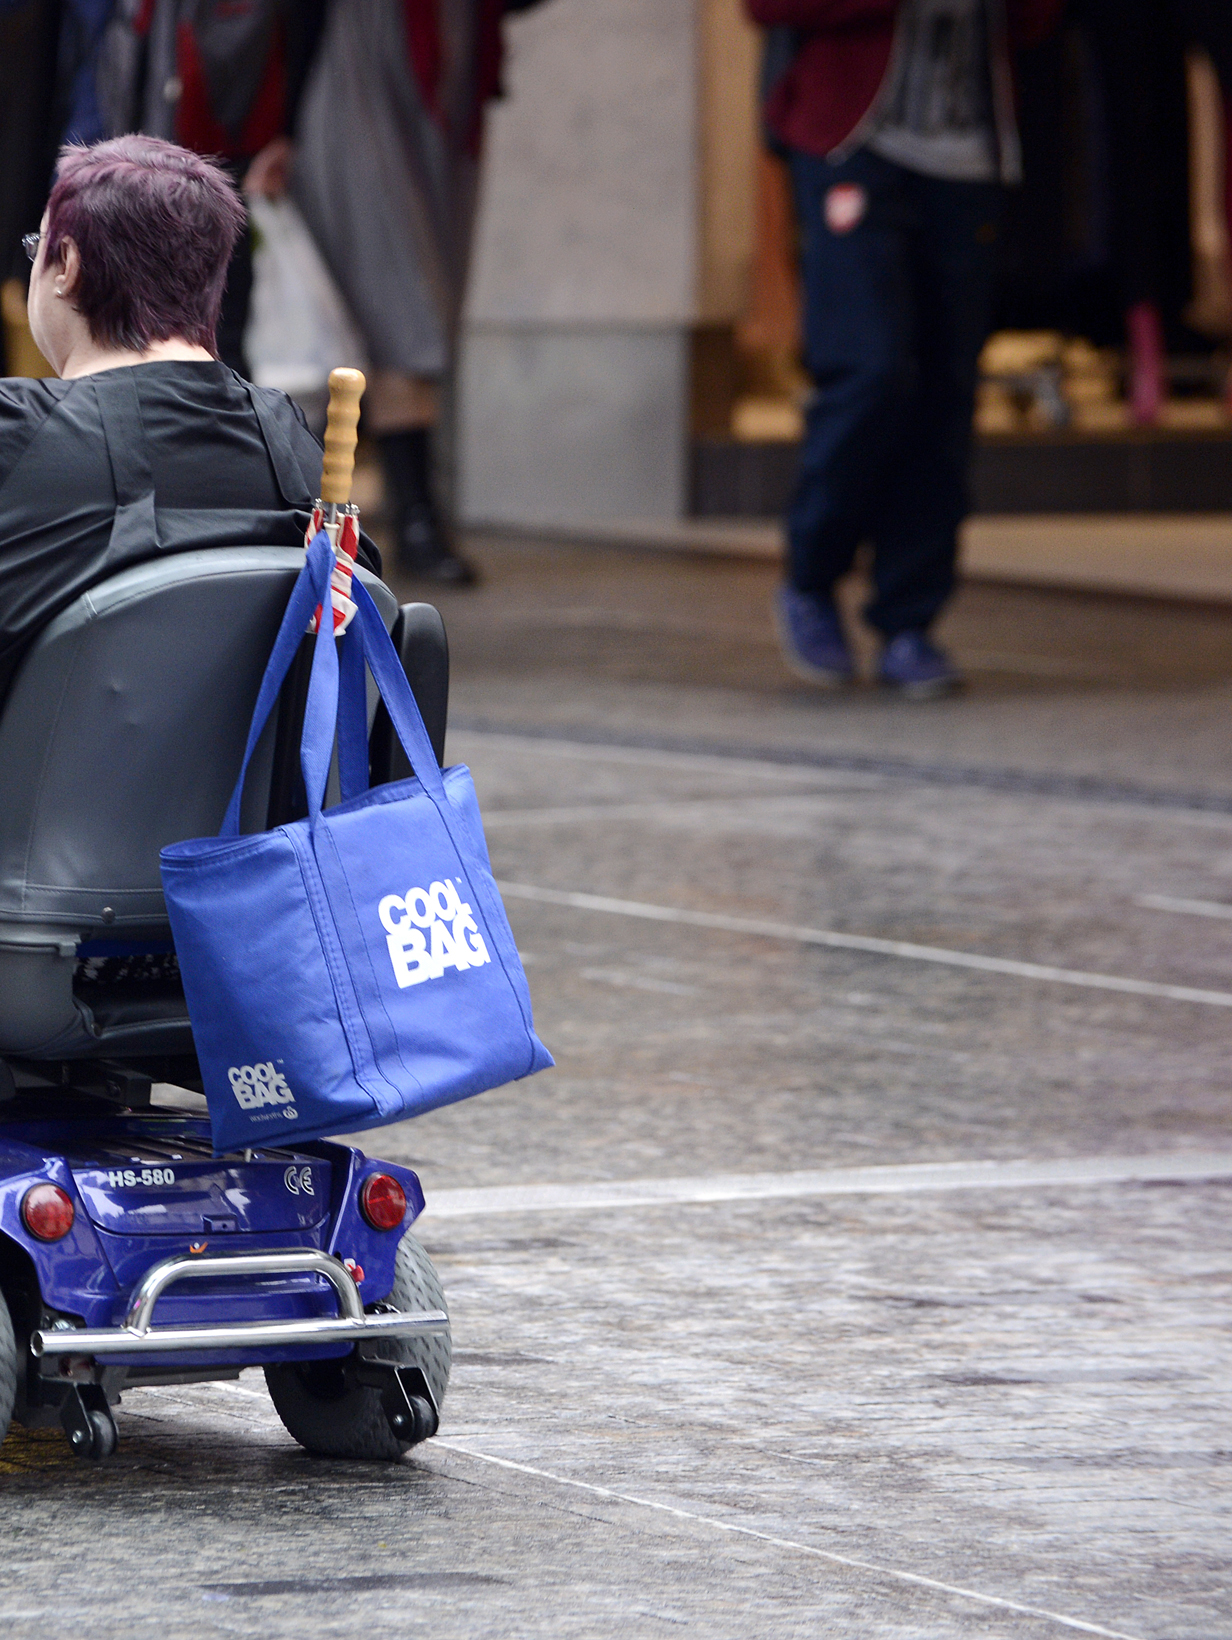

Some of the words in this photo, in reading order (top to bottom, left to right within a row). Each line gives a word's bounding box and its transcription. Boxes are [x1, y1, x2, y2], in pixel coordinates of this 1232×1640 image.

[378, 878, 473, 935] COOL
[386, 912, 491, 989] BAG
[228, 1062, 285, 1087] COOL
[231, 1079, 296, 1110] BAG
[108, 1168, 175, 1188] HS-580
[284, 1166, 314, 1195] CE
